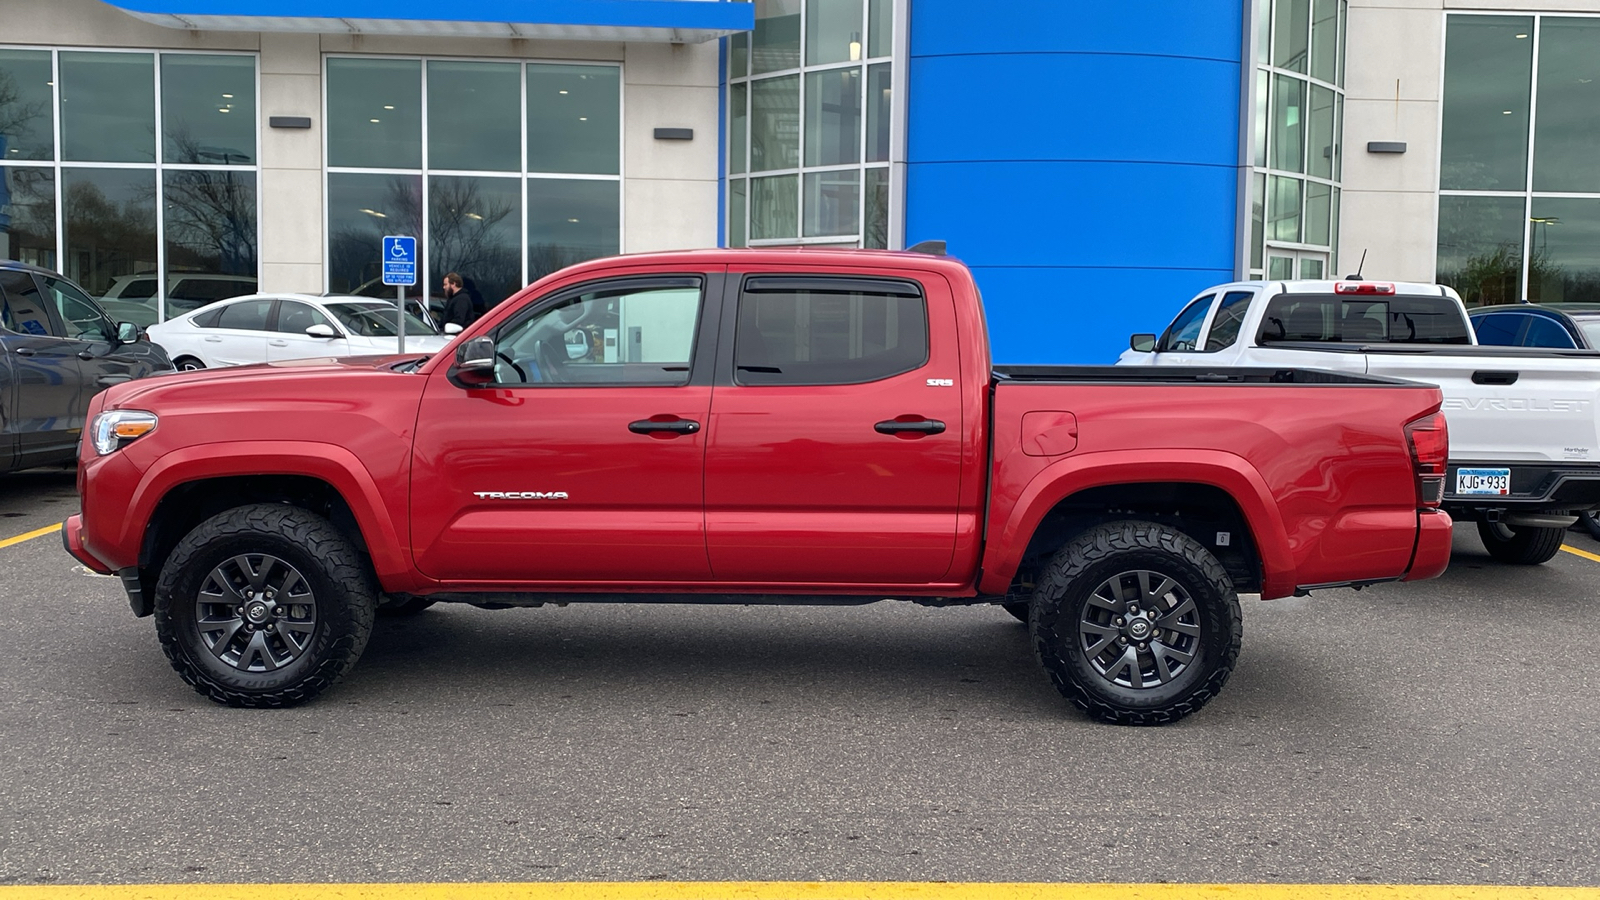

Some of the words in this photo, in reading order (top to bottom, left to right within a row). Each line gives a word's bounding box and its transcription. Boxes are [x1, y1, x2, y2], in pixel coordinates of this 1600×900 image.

[1442, 397, 1590, 412] EVROLET
[1459, 475, 1479, 489] KJG
[1487, 475, 1507, 489] 933
[473, 491, 568, 499] TACOMA
